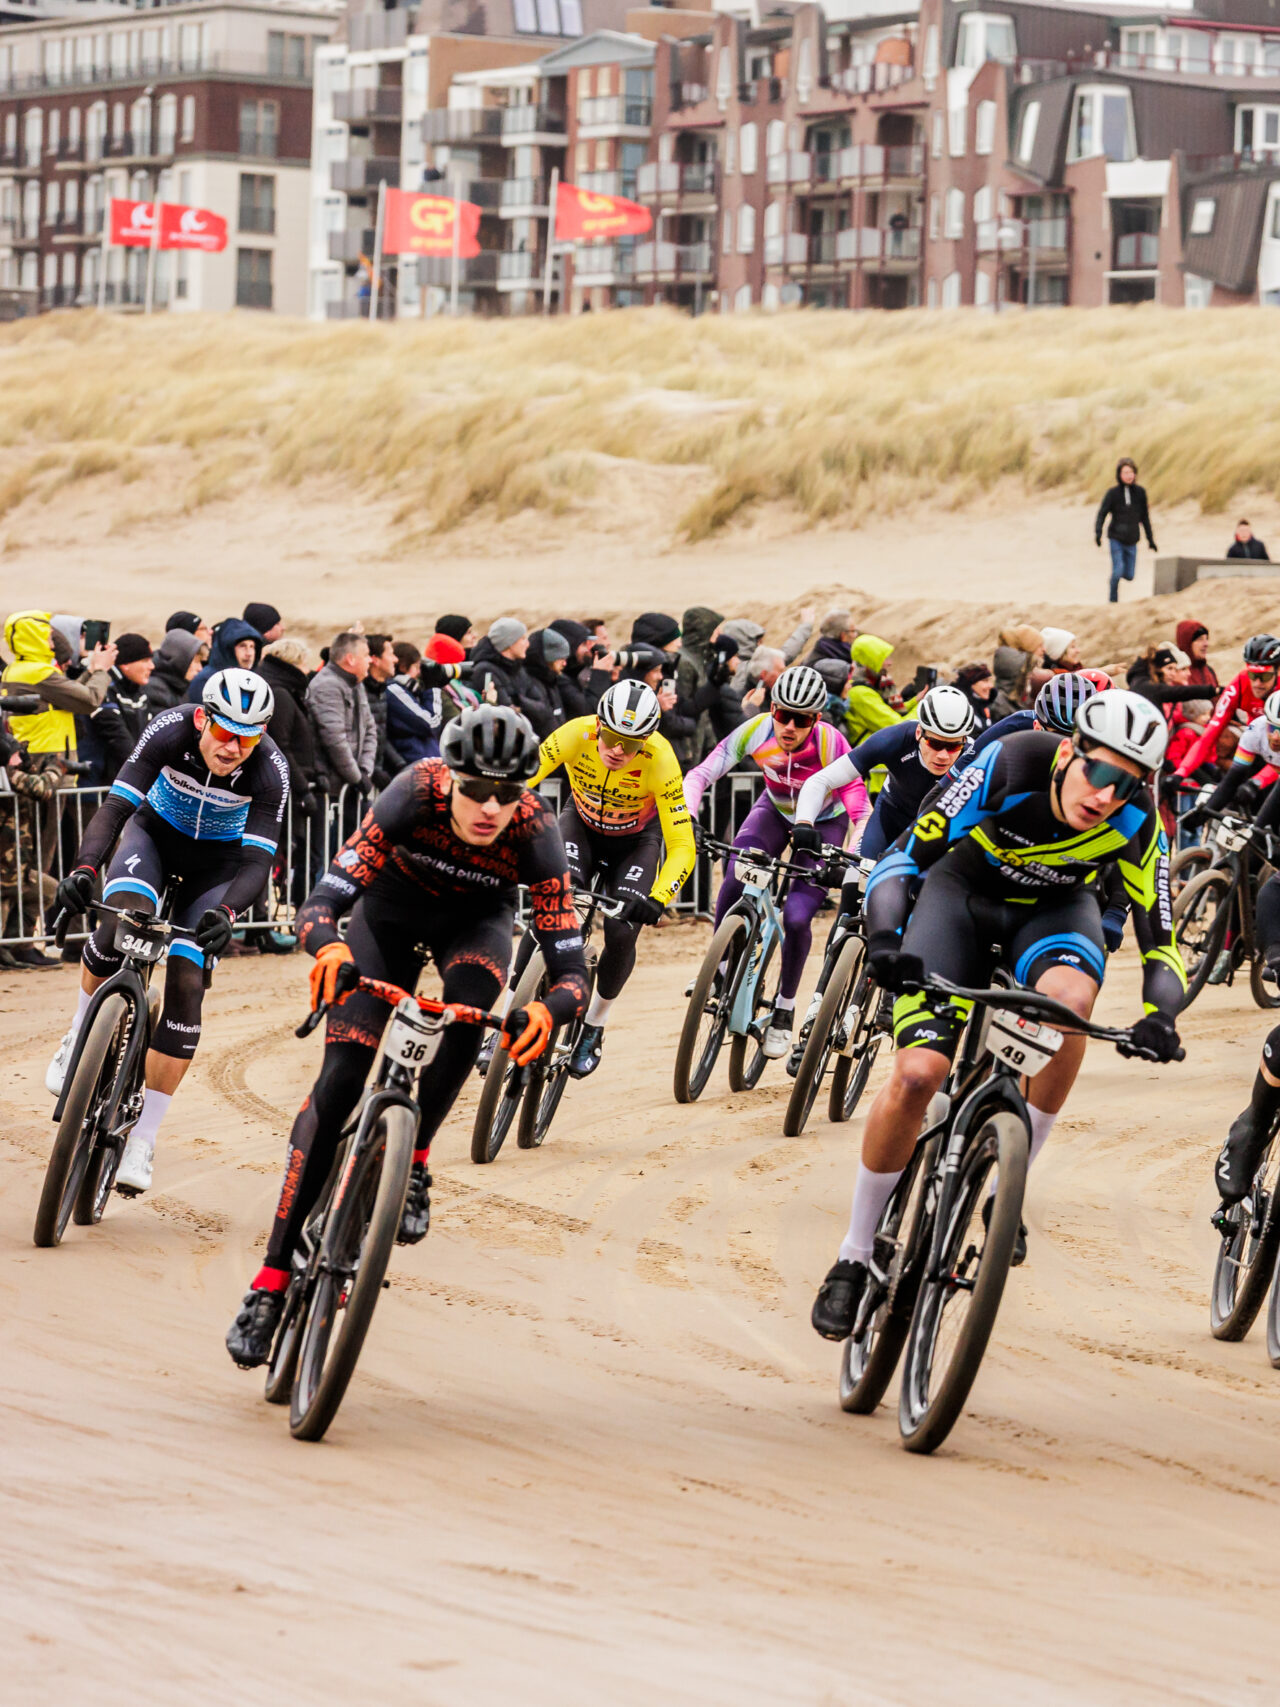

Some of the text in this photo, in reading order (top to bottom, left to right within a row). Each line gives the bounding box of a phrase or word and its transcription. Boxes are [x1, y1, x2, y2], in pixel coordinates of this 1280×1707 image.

[128, 711, 184, 764] VolkerWessels
[269, 751, 292, 823] VolkerWessels
[936, 766, 976, 810] HEILIG
[945, 768, 985, 818] GROUP
[411, 852, 499, 887] GOING DUTCH
[743, 871, 758, 883] 44
[1157, 854, 1173, 931] BEUKERS
[121, 934, 153, 956] 344
[400, 1039, 428, 1061] 36
[1000, 1045, 1026, 1065] 49
